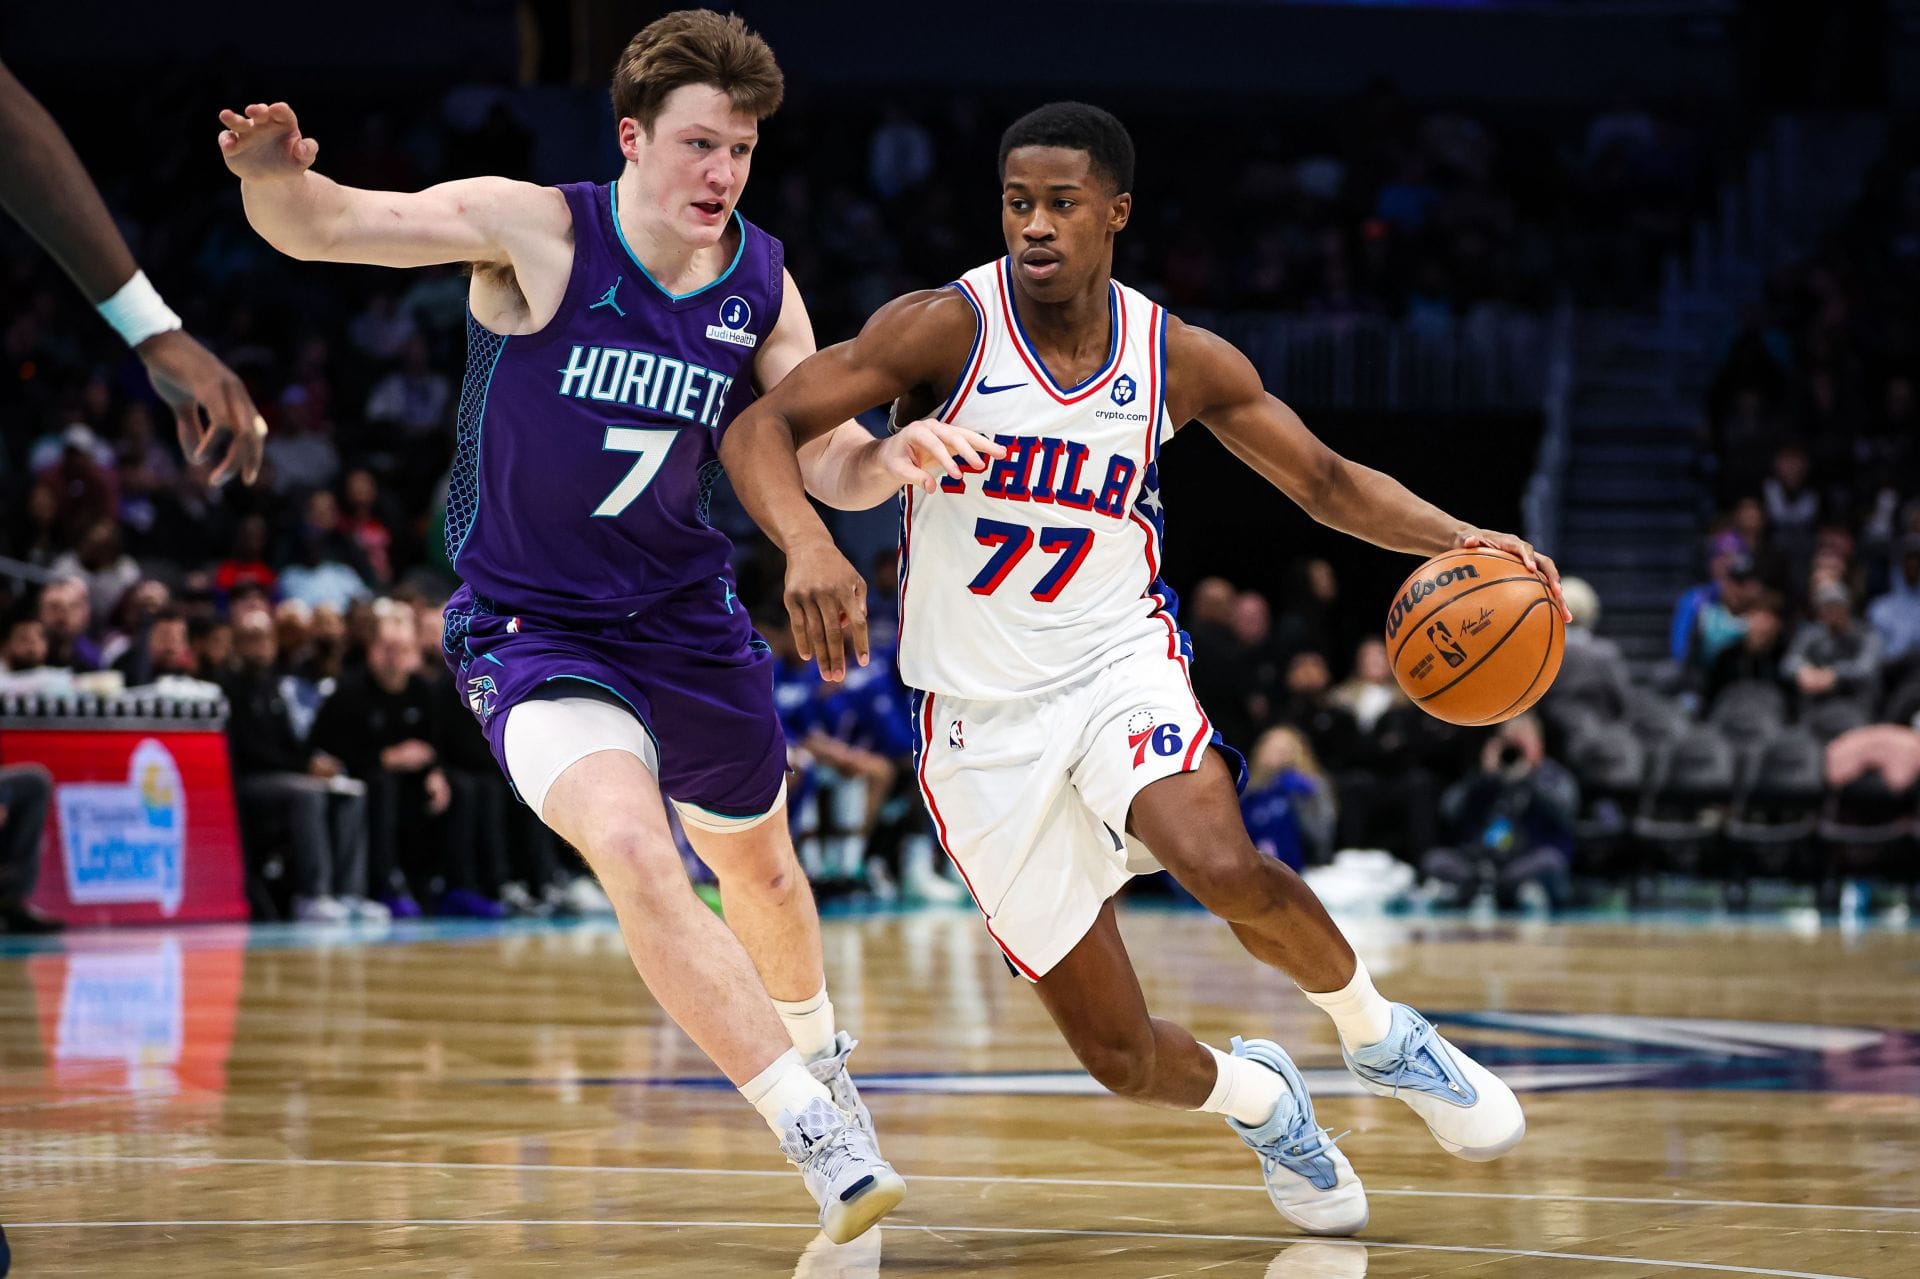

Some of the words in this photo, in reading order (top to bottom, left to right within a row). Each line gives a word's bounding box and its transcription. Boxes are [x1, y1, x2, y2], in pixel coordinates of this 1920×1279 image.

[557, 345, 734, 428] HORNETS
[1095, 409, 1148, 422] crypto.com
[589, 426, 683, 518] 7
[967, 517, 1095, 602] 77
[1387, 564, 1480, 640] Wilson
[1128, 723, 1183, 770] 76
